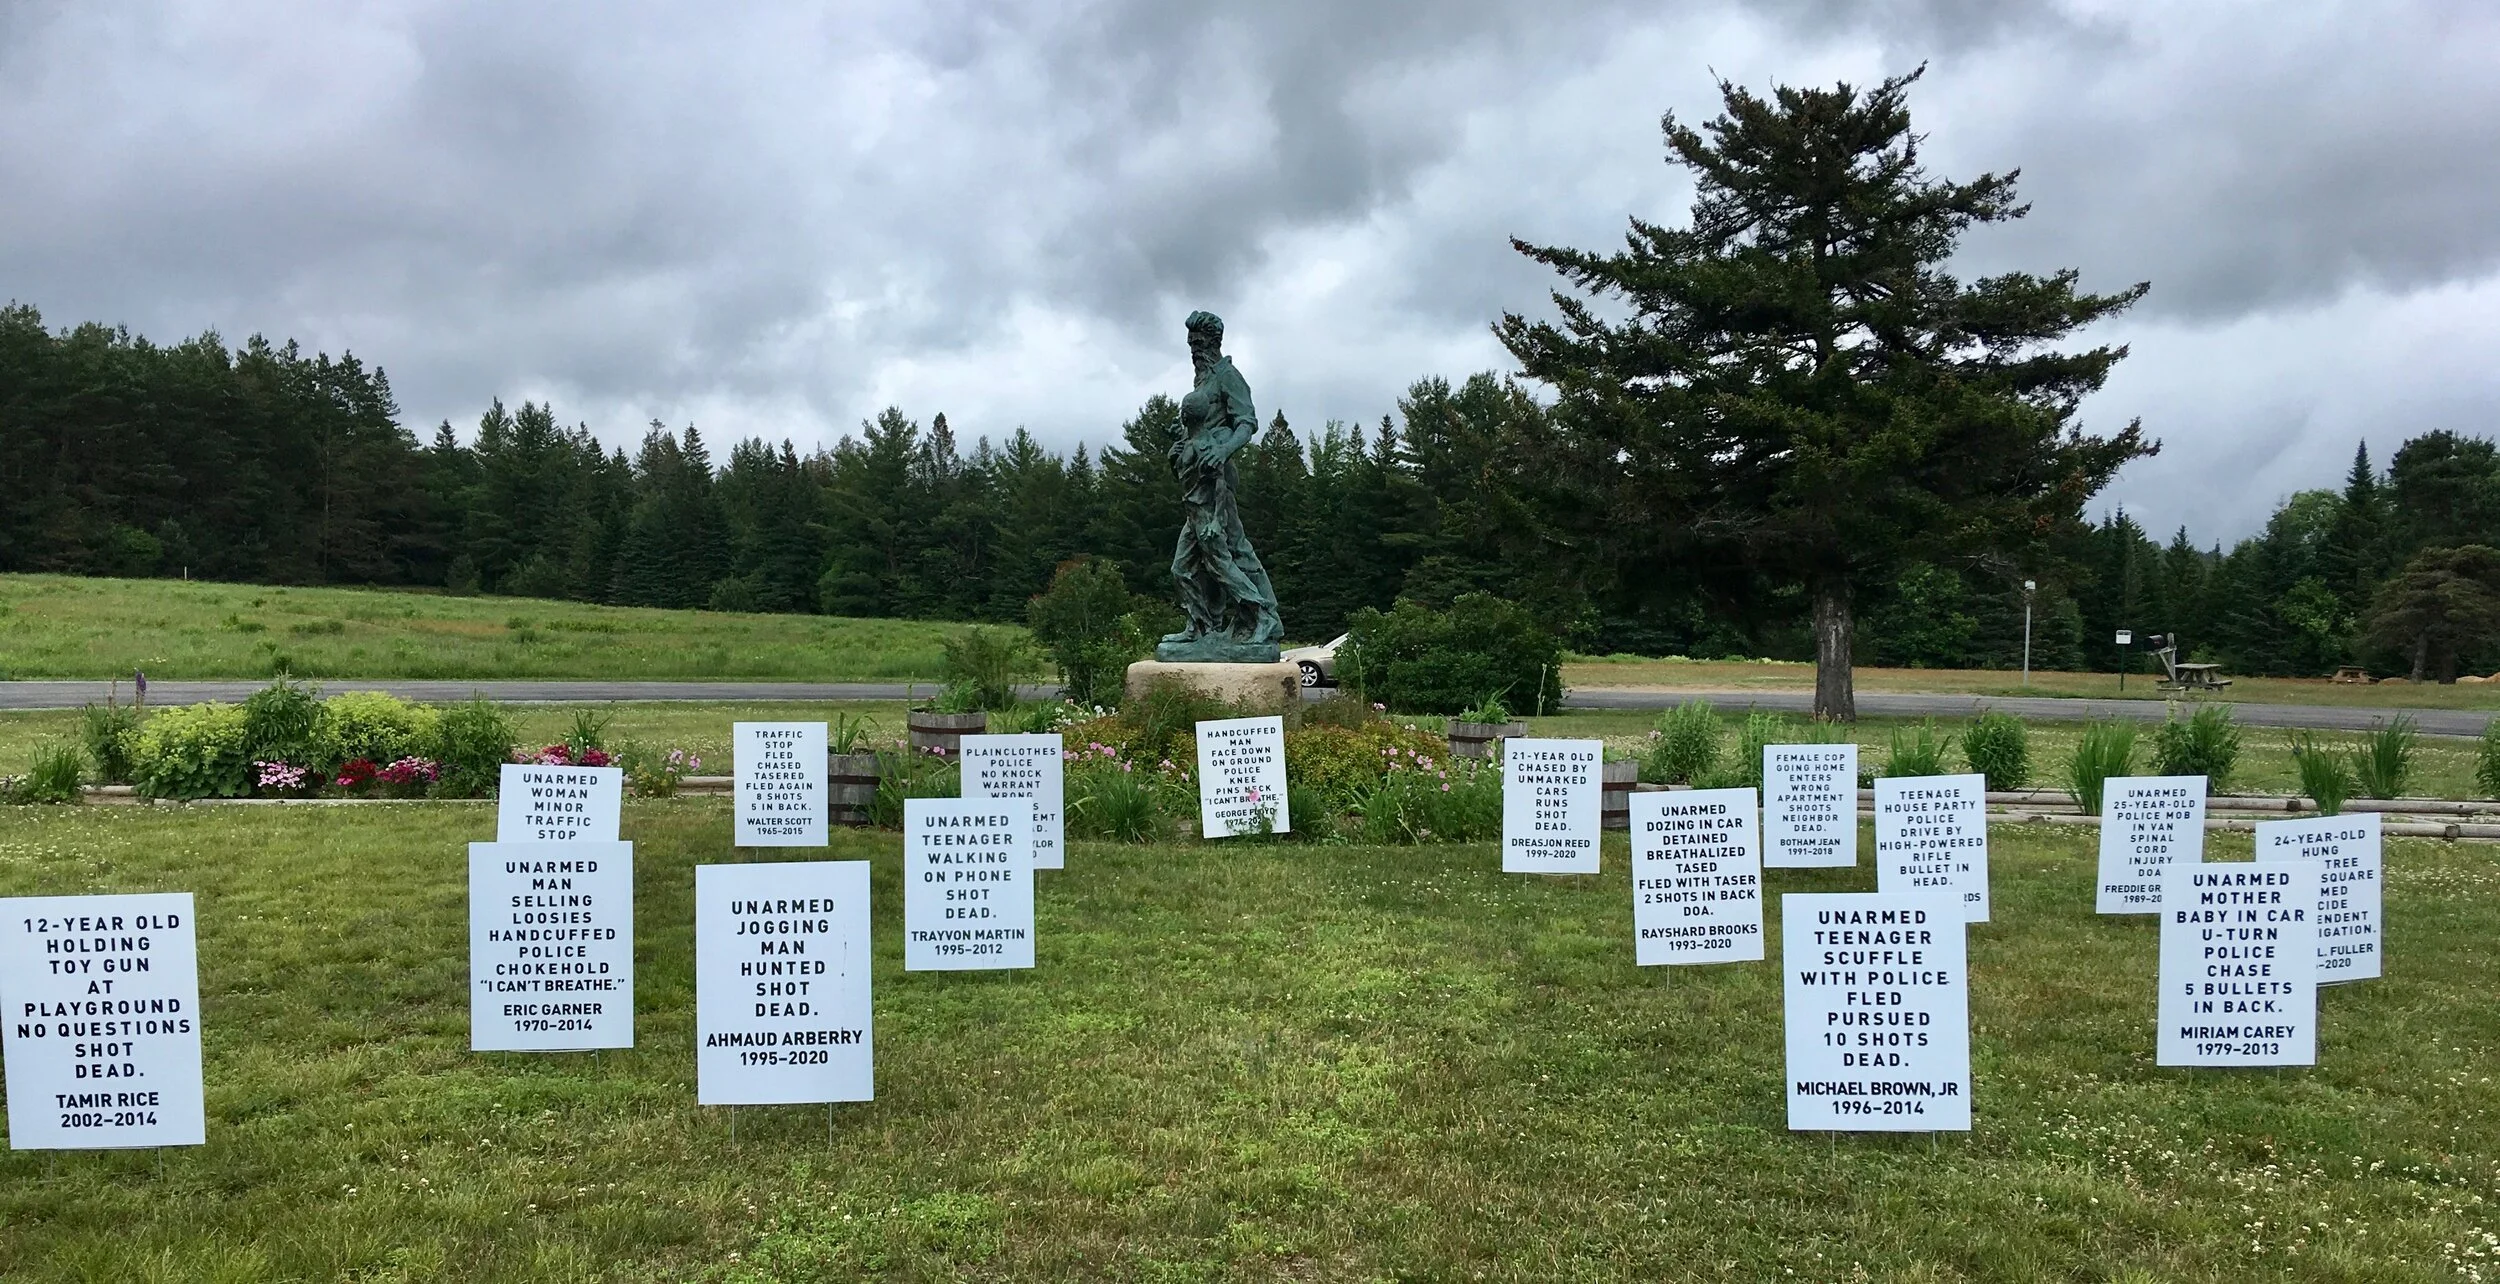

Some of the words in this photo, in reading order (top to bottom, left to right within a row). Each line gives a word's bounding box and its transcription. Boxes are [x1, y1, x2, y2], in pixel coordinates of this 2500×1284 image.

[755, 730, 803, 739] TRAFFIC
[1207, 726, 1276, 739] HANDCUFFED
[764, 740, 793, 749] STOP
[1229, 737, 1252, 747] MAN
[765, 751, 793, 760] FLED
[966, 747, 1056, 757] PLAINCLOTHES
[1211, 748, 1237, 758] FACE
[1241, 746, 1271, 756] DOWN
[1512, 751, 1565, 761] 21-YEAR
[1570, 752, 1594, 762] OLD
[1776, 753, 1819, 762] FEMALE
[1824, 753, 1846, 762] COP
[757, 761, 801, 770] CHASED
[990, 758, 1033, 768] POLICE
[1229, 755, 1272, 766] GROUND
[981, 770, 997, 779] NO
[1002, 769, 1042, 778] KNOCK
[1223, 765, 1261, 776] POLICE
[1518, 763, 1567, 773] CHASED
[1776, 763, 1810, 772] GOING
[1814, 763, 1845, 772] HOME
[522, 772, 599, 786] UNARMED
[754, 771, 805, 780] TASERED
[1229, 775, 1257, 785] KNEE
[1518, 774, 1587, 785] UNMARKED
[1789, 773, 1832, 782] ENTERS
[745, 782, 774, 791] FLED
[778, 782, 813, 791] AGAIN
[982, 780, 1041, 790] WARRANT
[1215, 786, 1240, 796] PINS
[1536, 786, 1568, 796] CARS
[1790, 783, 1830, 792] WRONG
[531, 787, 588, 799] WOMAN
[1777, 793, 1844, 802] APARTMENT
[1899, 788, 1960, 800] TEENAGE
[2128, 788, 2187, 798] UNARMED
[534, 801, 584, 813] MINOR
[1535, 798, 1568, 808] RUNS
[1789, 803, 1832, 812] SHOOTS
[1884, 802, 1928, 814] HOUSE
[1934, 800, 1976, 811] PARTY
[2113, 799, 2196, 810] 25-YEAR-OLD
[1215, 808, 1248, 819] GEORGE
[1535, 810, 1567, 820] SHOT
[1661, 804, 1727, 817] UNARMED
[2117, 811, 2161, 821] POLICE
[2165, 810, 2191, 820] MOB
[525, 814, 591, 827] TRAFFIC
[746, 817, 783, 826] WALTER
[784, 817, 813, 826] SCOTT
[925, 815, 1009, 828] UNARMED
[1782, 813, 1839, 822] NEIGHBOR
[1907, 813, 1955, 825] POLICE
[1535, 821, 1572, 831] DEAD.
[1646, 819, 1695, 832] DOZING
[1717, 817, 1743, 829] CAR
[1793, 824, 1827, 832] DEAD.
[2150, 822, 2175, 832] VAN
[537, 829, 577, 841] STOP
[1900, 826, 1940, 838] DRIVE
[2130, 833, 2175, 843] SPINAL
[2274, 829, 2366, 846] 24-YEAR-OLD
[921, 833, 1013, 846] TEENAGER
[1511, 838, 1563, 848] DREASJON
[1564, 838, 1591, 848] REED
[1662, 832, 1728, 846] DETAINED
[1779, 838, 1817, 847] BOTHAM
[1817, 838, 1841, 847] JEAN
[1879, 837, 1983, 851] HIGH-POWERED
[1646, 846, 1746, 861] BREATHALIZED
[2135, 845, 2168, 854] CORD
[2302, 845, 2339, 858] HUNG
[927, 851, 1008, 865] WALKING
[1913, 851, 1951, 862] RIFLE
[2128, 856, 2173, 865] INJURY
[505, 860, 598, 874] UNARMED
[1675, 861, 1718, 874] TASED
[1899, 863, 1950, 875] BULLET
[2324, 857, 2359, 870] TREE
[924, 871, 946, 883] ON
[954, 870, 1012, 883] PHONE
[1638, 878, 1672, 890] FLED
[1675, 876, 1710, 888] WITH
[1713, 874, 1757, 887] TASER
[1913, 876, 1953, 887] HEAD.
[2193, 872, 2290, 887] UNARMED
[2320, 869, 2375, 884] SQUARE
[532, 877, 572, 891] MAN
[2104, 884, 2147, 894] FREDDIE
[511, 894, 592, 908] SELLING
[946, 888, 990, 901] SHOT
[2200, 891, 2281, 905] MOTHER
[731, 898, 834, 915] UNARMED
[1683, 905, 1714, 917] DOA.
[512, 911, 592, 925] LOOSIES
[945, 907, 997, 920] DEAD.
[1818, 910, 1926, 925] UNARMED
[2176, 910, 2228, 924] BABY
[2237, 909, 2257, 923] IN
[2267, 909, 2305, 922] CAR
[23, 916, 124, 933] 12-YEAR
[135, 914, 180, 930] OLD
[736, 919, 829, 936] JOGGING
[489, 928, 616, 942] HANDCUFFED
[910, 929, 971, 942] TRAYVON
[974, 928, 1025, 941] MARTIN
[1641, 926, 1706, 939] RAYSHARD
[1708, 923, 1758, 936] BROOKS
[1813, 930, 1932, 945] TEENAGER
[2202, 927, 2278, 942] U-TURN
[46, 936, 150, 954] HOLDING
[761, 940, 805, 956] MAN
[2330, 942, 2375, 957] FULLER
[519, 945, 586, 959] POLICE
[1823, 950, 1923, 966] SCUFFLE
[2204, 945, 2275, 960] POLICE
[48, 959, 91, 975] TOY
[103, 957, 149, 973] GUN
[496, 962, 609, 976] CHOKEHOLD
[741, 960, 827, 977] HUNTED
[2207, 963, 2271, 978] CHASE
[1800, 971, 1856, 986] WITH
[1868, 971, 1950, 986] POLICE
[87, 979, 114, 995] AT
[756, 981, 810, 997] SHOT
[1847, 991, 1902, 1006] FLED
[24, 998, 181, 1018] PLAYGROUND
[503, 1003, 538, 1017] ERIC
[541, 1002, 603, 1016] GARNER
[755, 1002, 819, 1018] DEAD.
[2194, 1000, 2213, 1014] IN
[2223, 1000, 2283, 1014] BACK.
[1827, 1011, 1930, 1026] PURSUED
[17, 1023, 47, 1039] NO
[57, 1019, 191, 1038] QUESTIONS
[2180, 1026, 2239, 1039] MIRIAM
[2243, 1025, 2296, 1039] CAREY
[706, 1032, 778, 1048] AHMAUD
[781, 1029, 863, 1047] ARBERRY
[74, 1041, 134, 1058] SHOT
[1843, 1052, 1909, 1067] DEAD.
[75, 1062, 145, 1079] DEAD.
[1796, 1081, 1868, 1096] MICHAEL
[1870, 1081, 1936, 1099] BROWN,
[1937, 1081, 1959, 1096] JR
[55, 1093, 113, 1109] TAMIR
[117, 1091, 160, 1108] RICE
